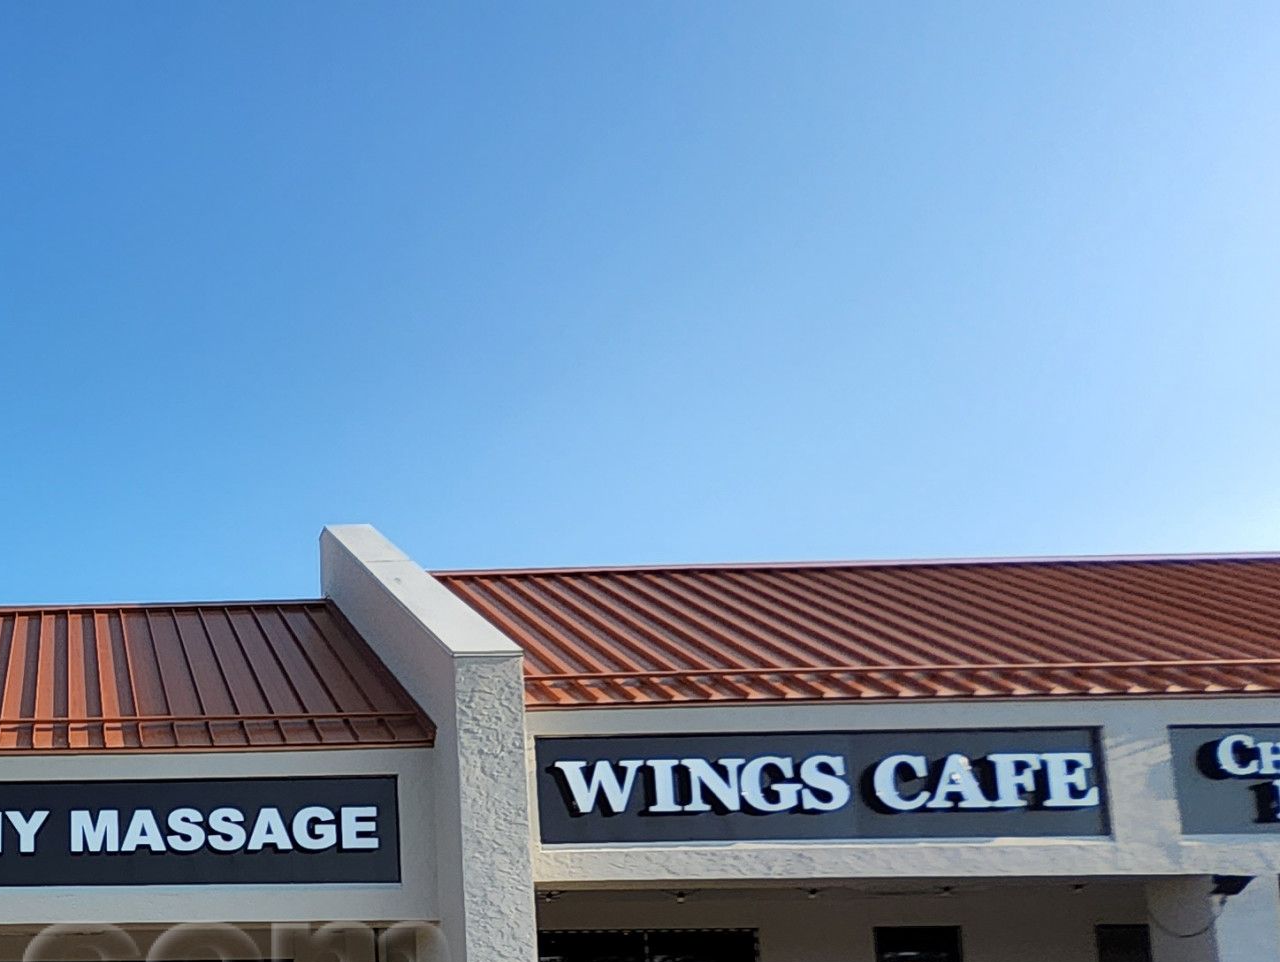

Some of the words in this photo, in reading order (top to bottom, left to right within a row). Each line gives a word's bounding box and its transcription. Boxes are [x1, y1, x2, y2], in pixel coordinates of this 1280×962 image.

[554, 756, 851, 815] WINGS
[873, 751, 1100, 812] CAFE
[70, 806, 380, 853] MASSAGE
